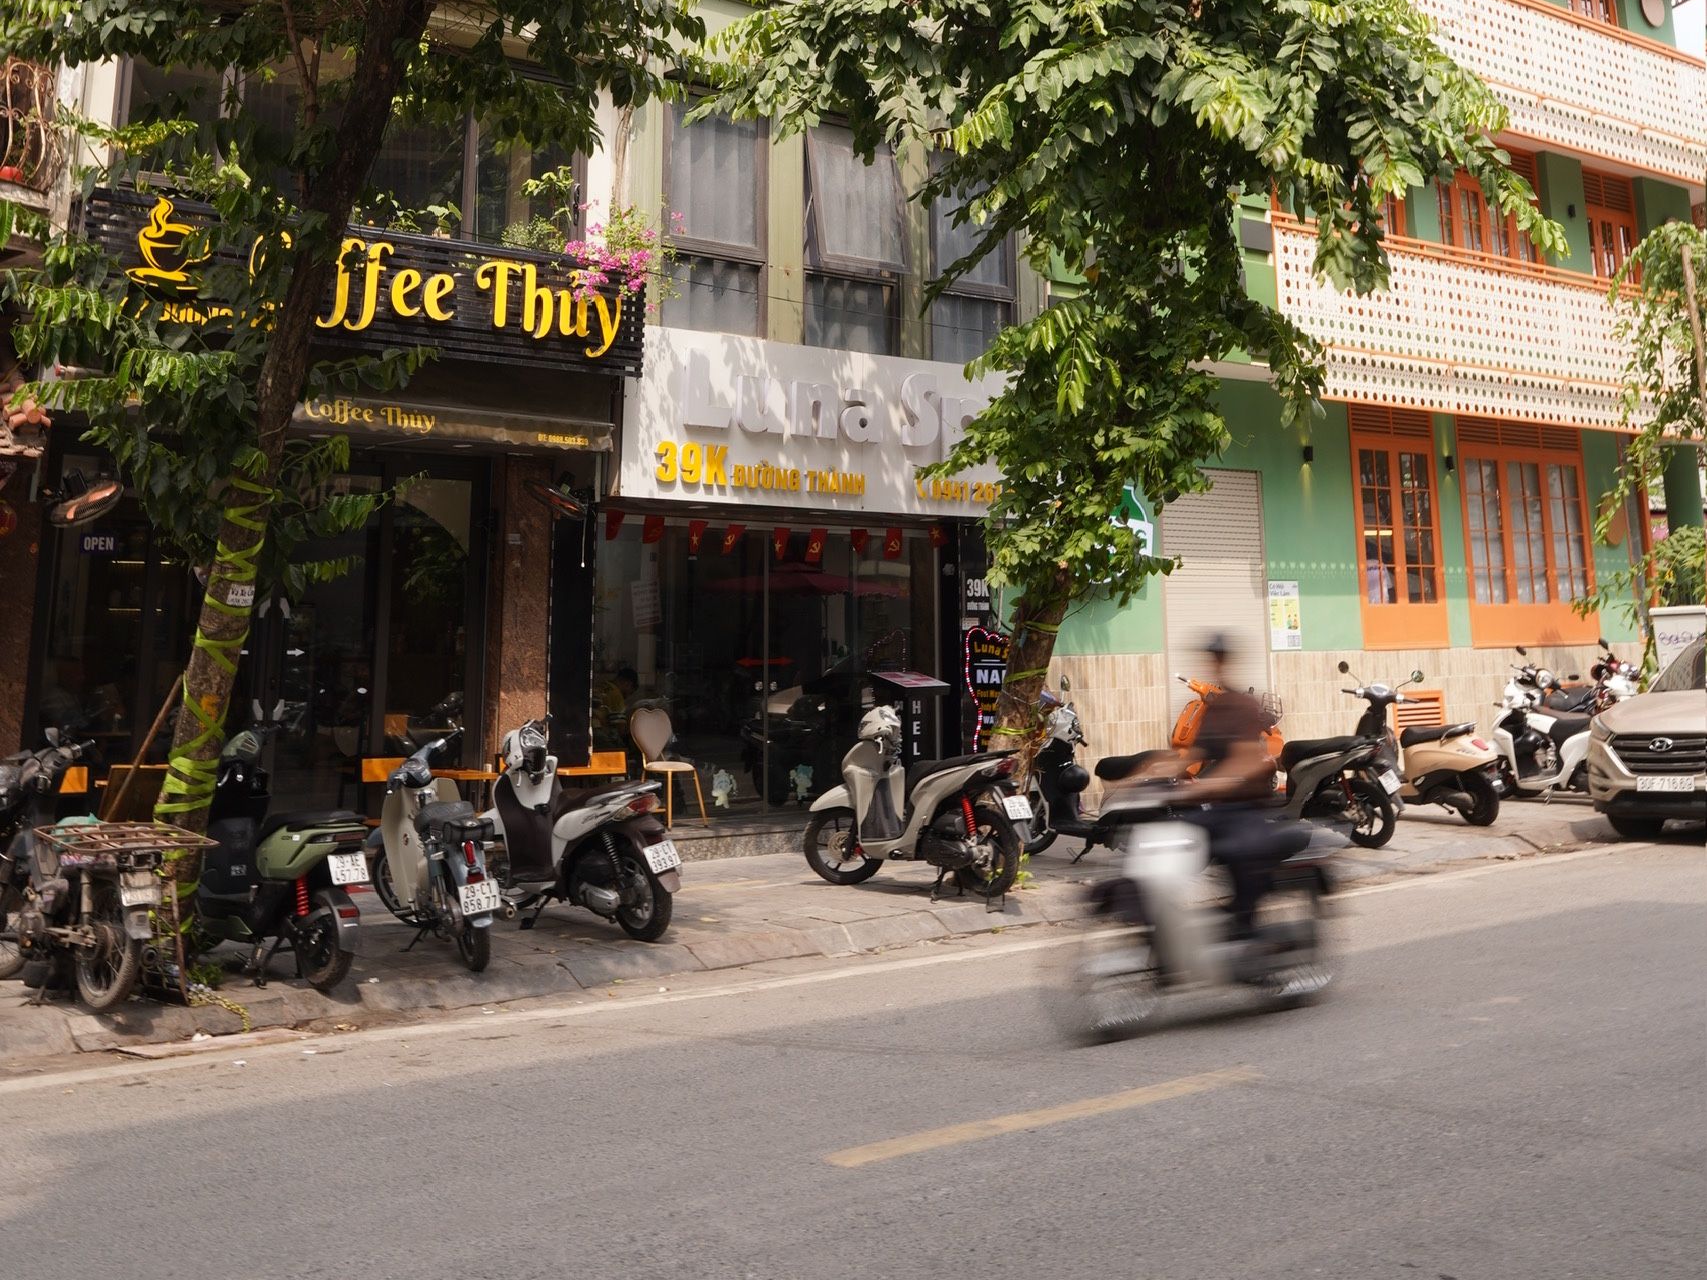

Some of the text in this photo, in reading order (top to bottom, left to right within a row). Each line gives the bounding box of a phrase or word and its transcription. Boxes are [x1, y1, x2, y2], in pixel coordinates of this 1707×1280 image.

[304, 398, 374, 425] Coffee
[683, 348, 988, 462] Luna Sp
[655, 440, 728, 487] 39K
[731, 458, 800, 492] ĐƯỜNG
[805, 466, 865, 496] THÀNH
[930, 478, 970, 503] 0941
[83, 536, 115, 551] OPEN
[966, 578, 990, 597] 39K
[973, 640, 1003, 658] Luna
[649, 843, 673, 859] 29-C1
[464, 882, 492, 899] 29-C1
[463, 895, 497, 913] 858.77
